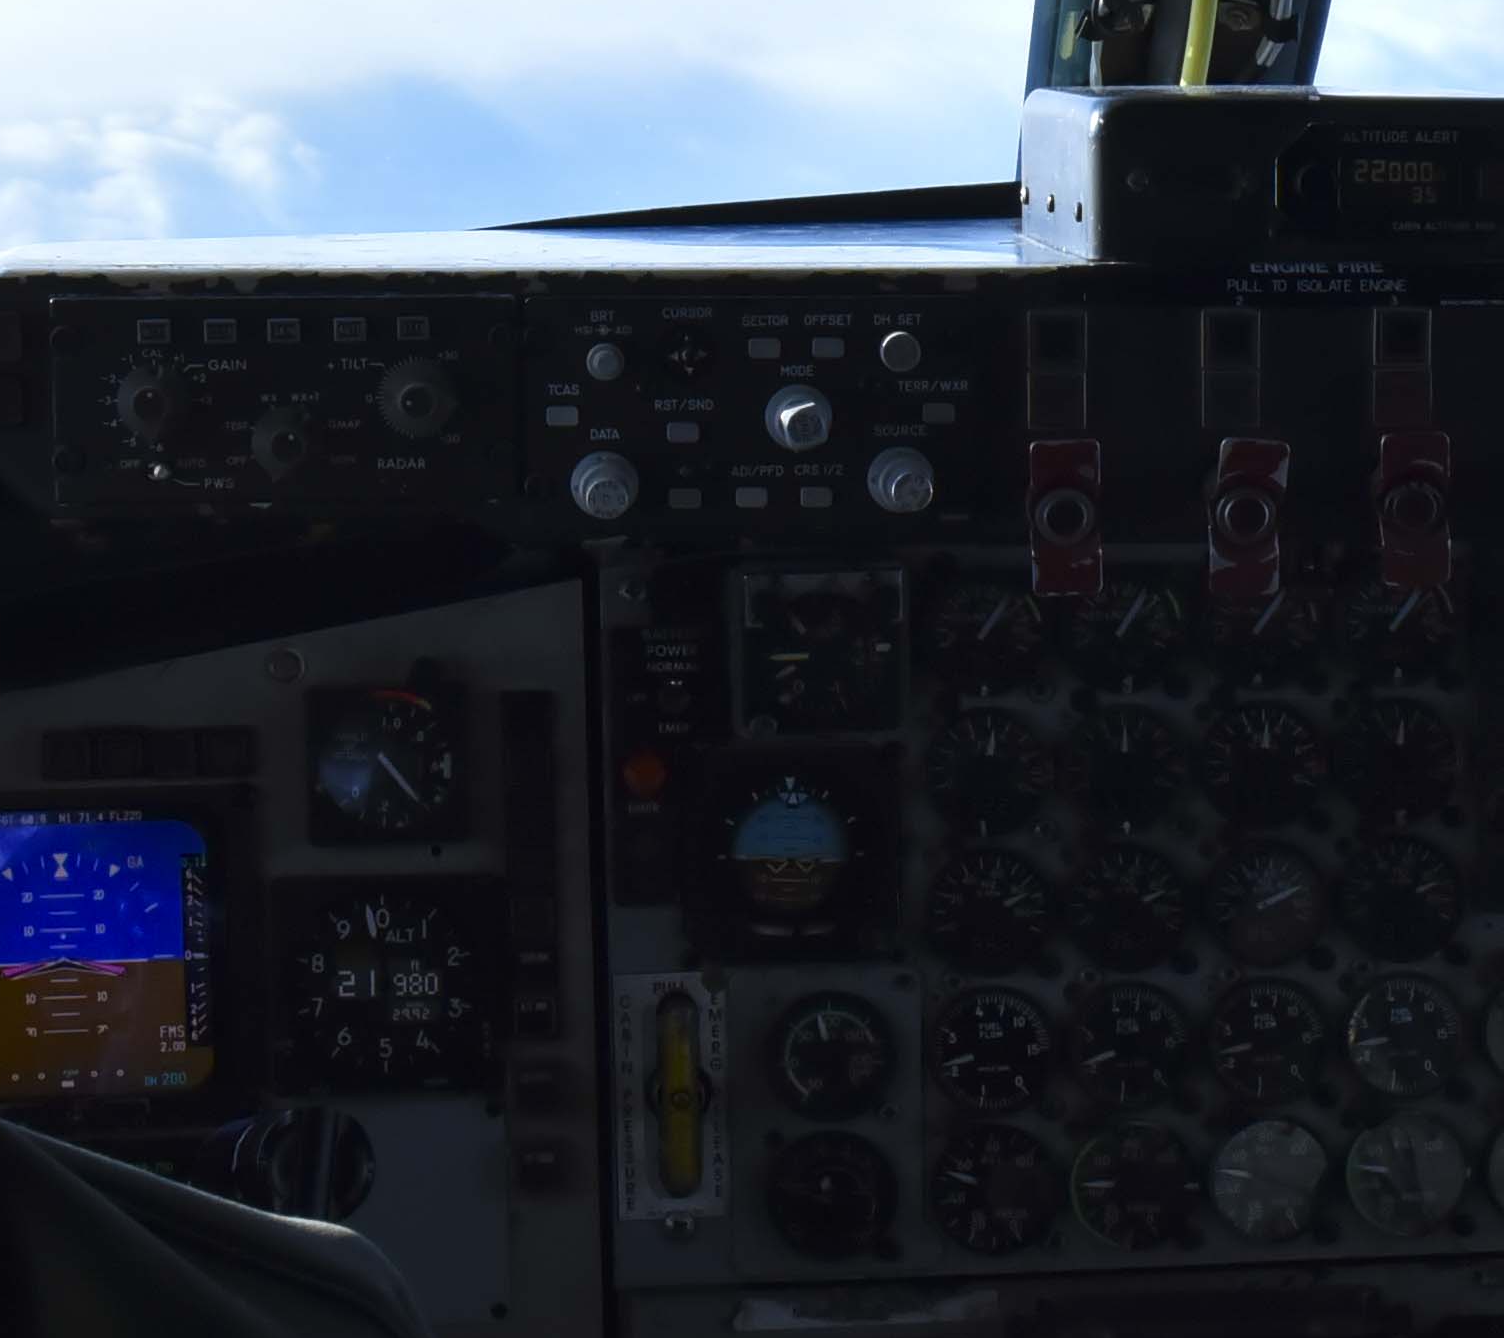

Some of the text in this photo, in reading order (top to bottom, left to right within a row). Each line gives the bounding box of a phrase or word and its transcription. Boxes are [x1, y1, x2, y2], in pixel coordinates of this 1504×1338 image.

[1415, 130, 1460, 144] ALERT
[1353, 159, 1434, 182] 22000
[1226, 278, 1408, 293] PULL TO ISOLATE ENGINE
[590, 310, 615, 323] BRT
[661, 306, 713, 319] CURSOR
[741, 314, 790, 327] SECTOR
[803, 313, 853, 327] OFFSET
[896, 313, 922, 327] SET
[207, 357, 247, 372] GAIN
[340, 357, 368, 371] TILT
[779, 364, 816, 377] MODE
[547, 382, 581, 396] TCAS
[898, 379, 969, 392] TERR/WXR
[653, 398, 714, 412] RST/SND
[590, 427, 621, 441] DATA
[873, 424, 929, 437] SOURCE
[376, 457, 427, 470] RADAR
[203, 477, 235, 491] PWS
[376, 910, 390, 930] 0
[335, 919, 351, 939] 9
[384, 927, 415, 943] ALT
[310, 952, 325, 974] 8
[448, 947, 464, 968] 2
[393, 973, 439, 997] 980
[448, 996, 463, 1018] 3
[1012, 1015, 1027, 1029] 10
[159, 1024, 185, 1038] FMS
[337, 1026, 352, 1047] 6
[415, 1028, 431, 1050] 4
[378, 1037, 394, 1059] 5
